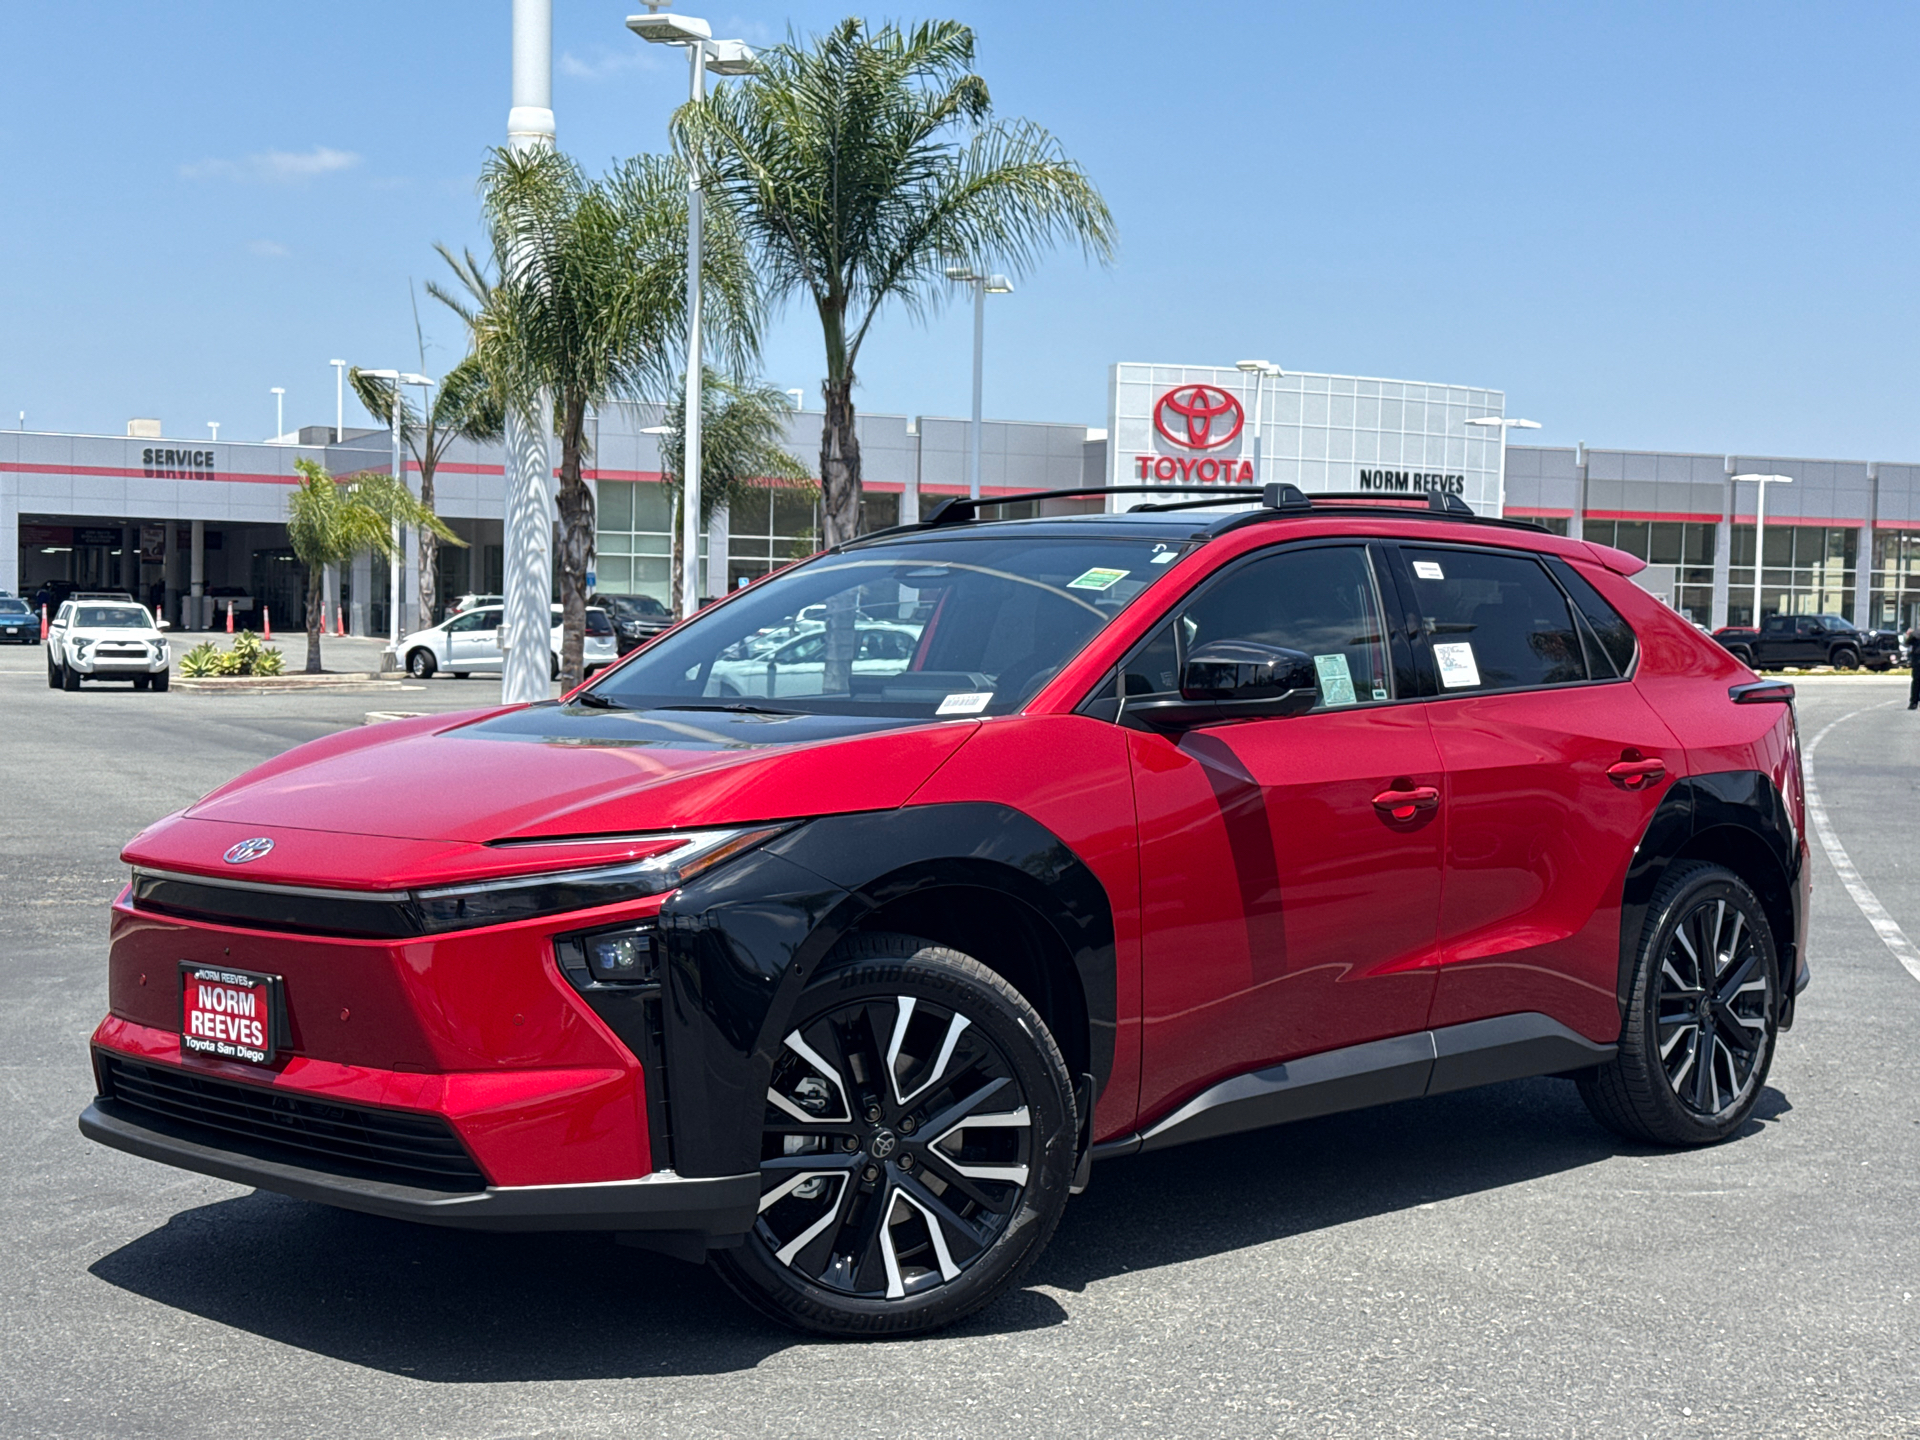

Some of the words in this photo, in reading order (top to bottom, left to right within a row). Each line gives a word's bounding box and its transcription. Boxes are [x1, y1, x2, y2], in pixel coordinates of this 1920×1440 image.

[143, 448, 215, 467] SERVICE
[1135, 456, 1253, 483] TOYOTA
[1359, 469, 1409, 491] NORM
[1413, 473, 1465, 495] REEVES
[199, 969, 220, 981] NORM
[221, 973, 248, 986] REEVES
[198, 985, 255, 1017] NORM
[191, 1010, 264, 1046] REEVES
[184, 1035, 215, 1051] Toyota
[217, 1042, 235, 1055] San
[237, 1046, 264, 1062] Diego
